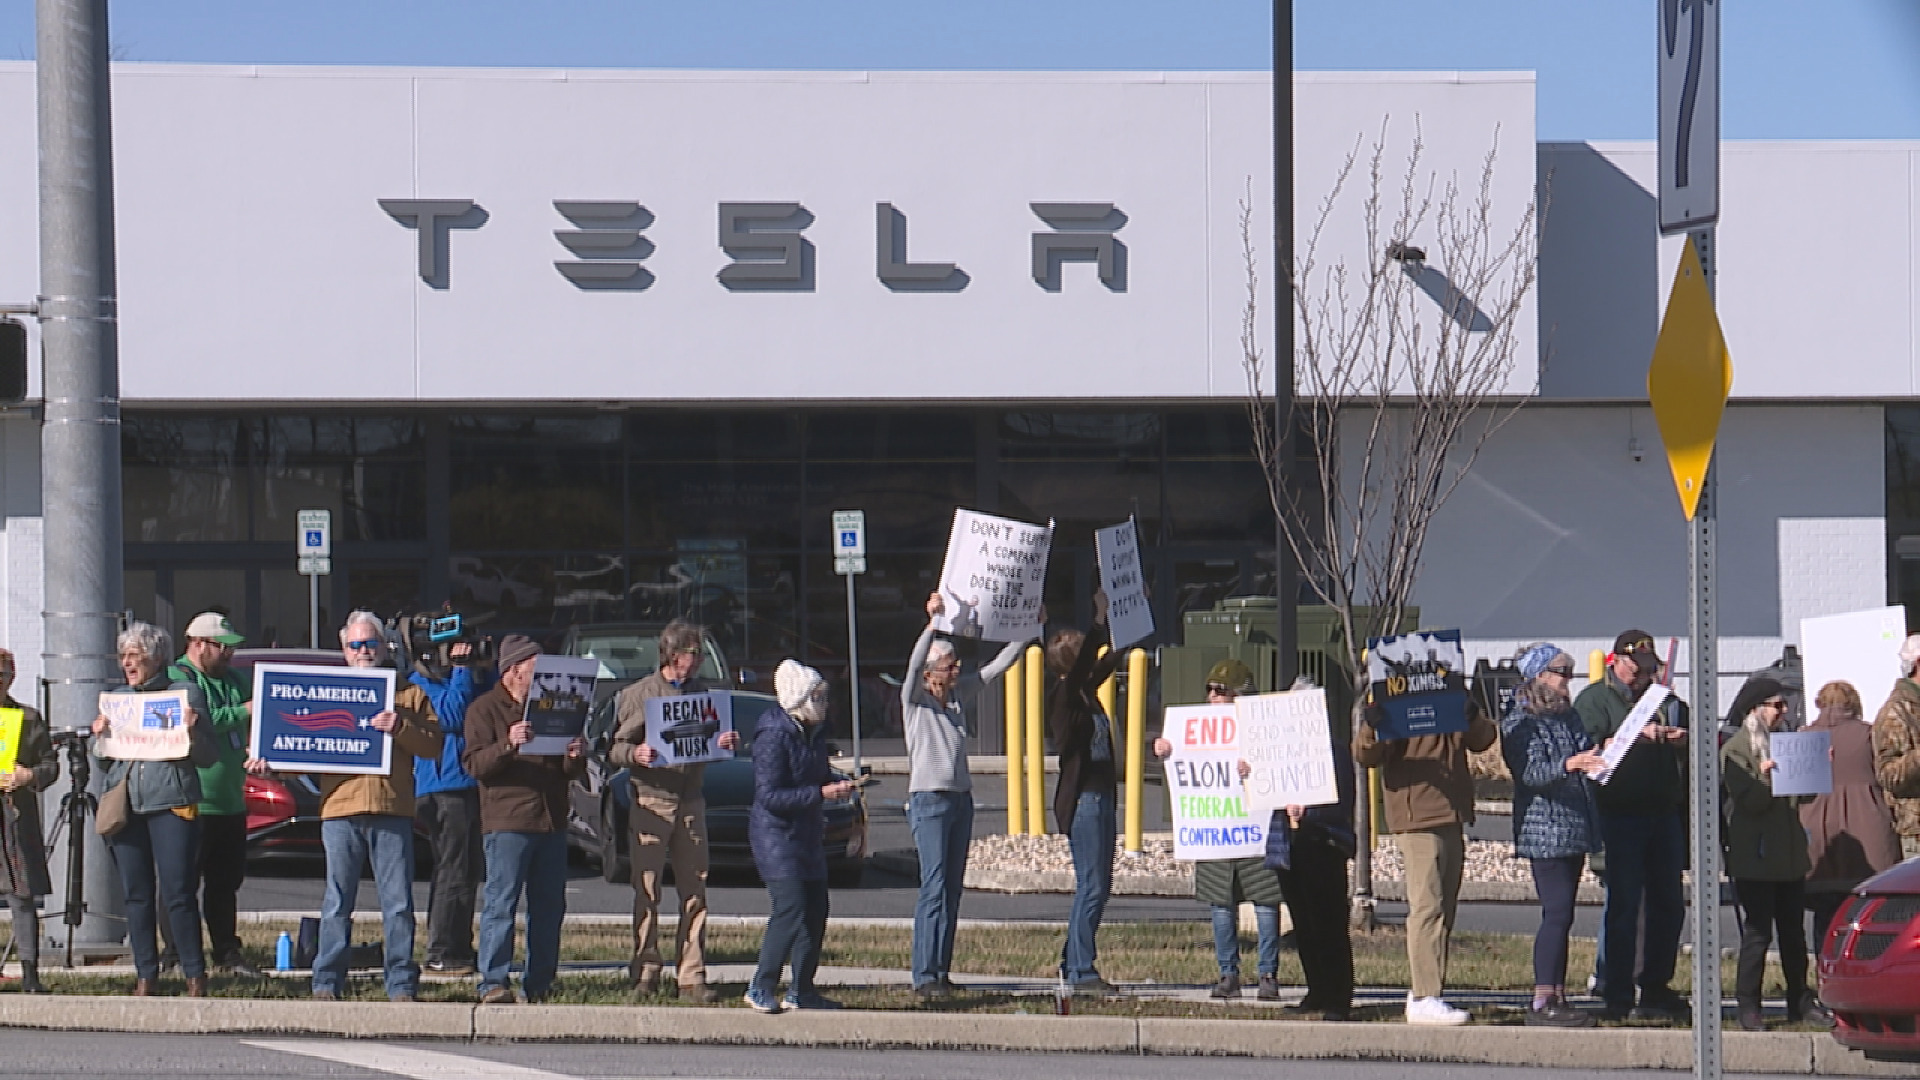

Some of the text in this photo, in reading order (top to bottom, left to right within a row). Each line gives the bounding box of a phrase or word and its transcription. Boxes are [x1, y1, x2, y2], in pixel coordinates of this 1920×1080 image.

[378, 199, 1128, 292] TESLA
[971, 519, 1014, 541] DON'T
[979, 541, 989, 556] A
[970, 573, 1023, 597] DOES THE
[270, 684, 378, 703] PRO-AMERICA
[1386, 677, 1406, 696] NO
[1184, 716, 1237, 745] END
[272, 736, 370, 753] ANTI-TRUMP
[673, 738, 709, 758] MUSK
[1174, 760, 1231, 788] ELON
[1179, 796, 1248, 818] FEDERAL
[1179, 824, 1262, 846] CONTRACTS
